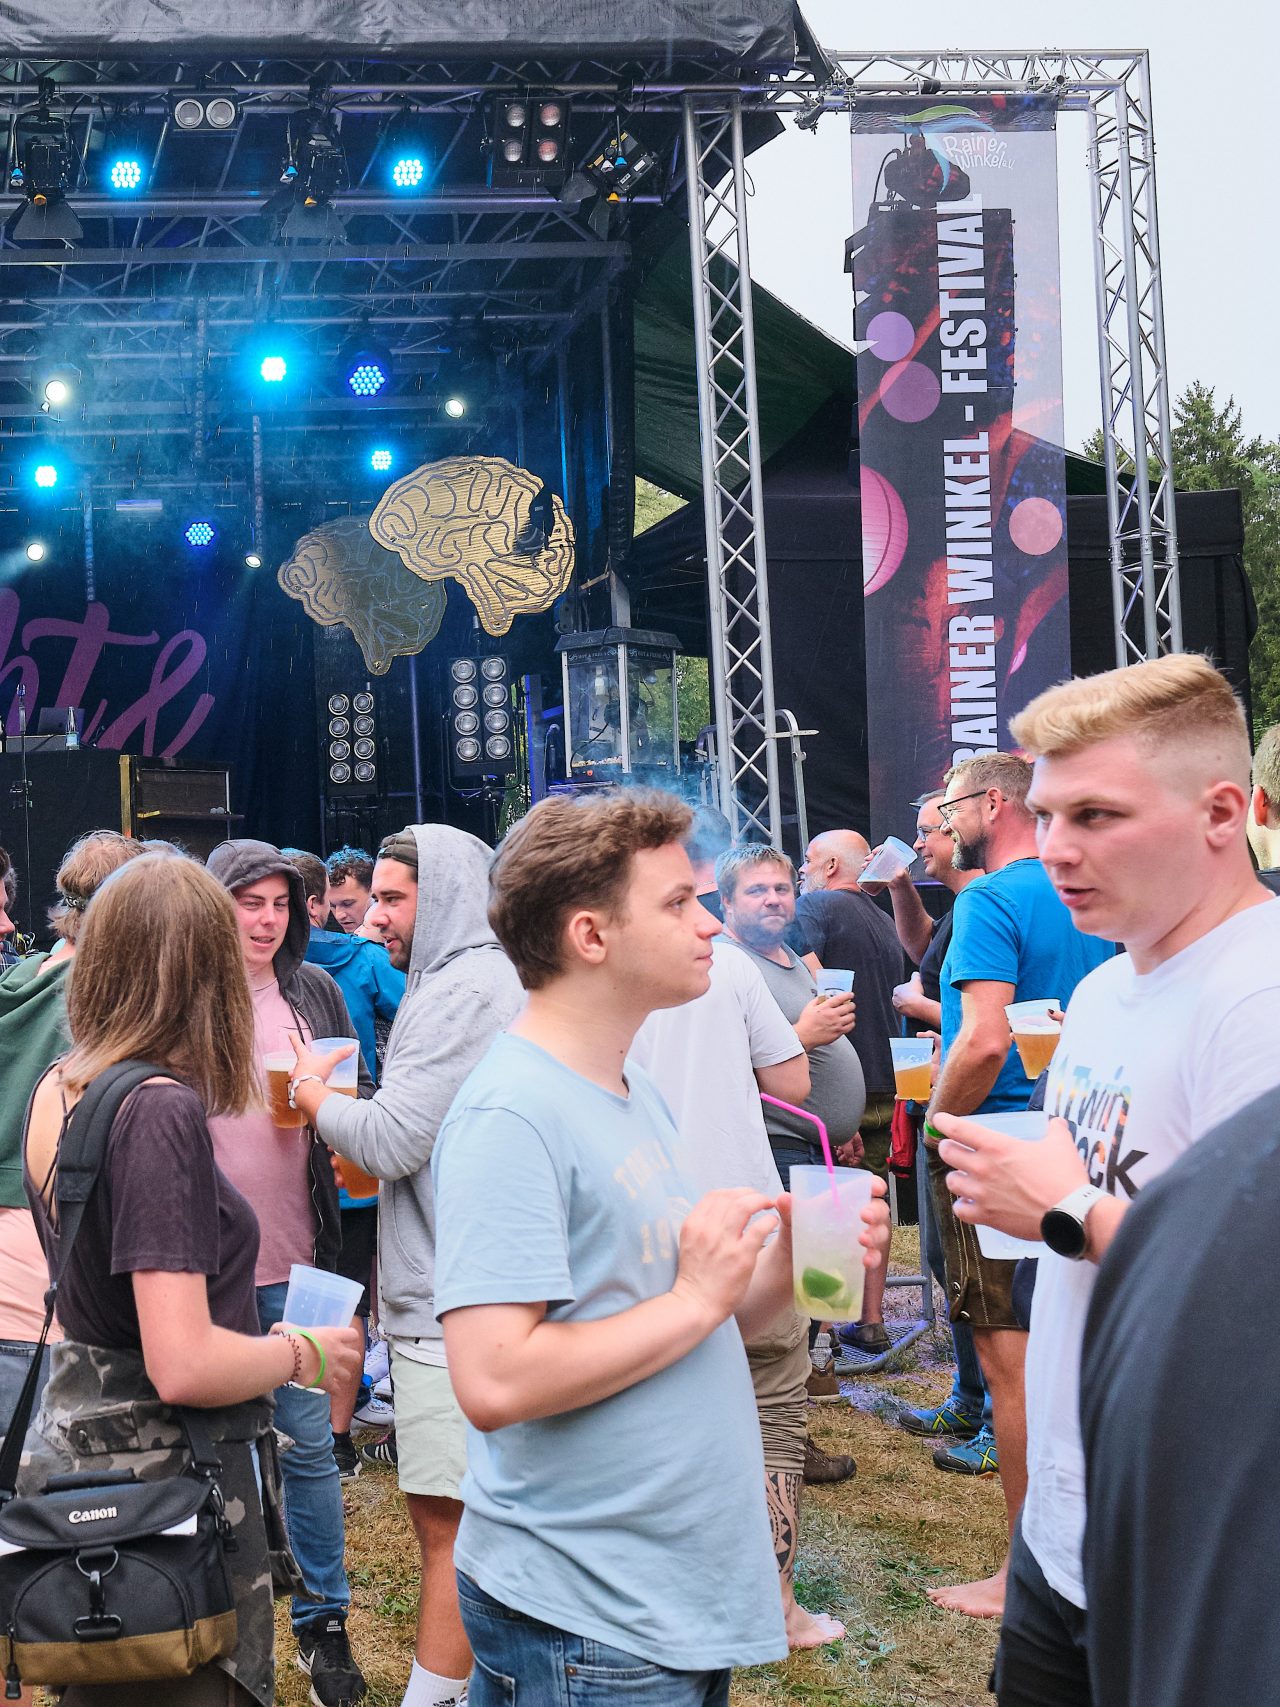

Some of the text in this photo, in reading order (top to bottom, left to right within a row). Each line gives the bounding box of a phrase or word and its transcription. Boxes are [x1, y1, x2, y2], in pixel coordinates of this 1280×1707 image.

[943, 131, 1008, 157] Rainer
[954, 150, 1005, 169] Winkel
[936, 193, 989, 393] FESTIVAL
[943, 431, 995, 606] WINKEL
[68, 1505, 118, 1525] Canon
